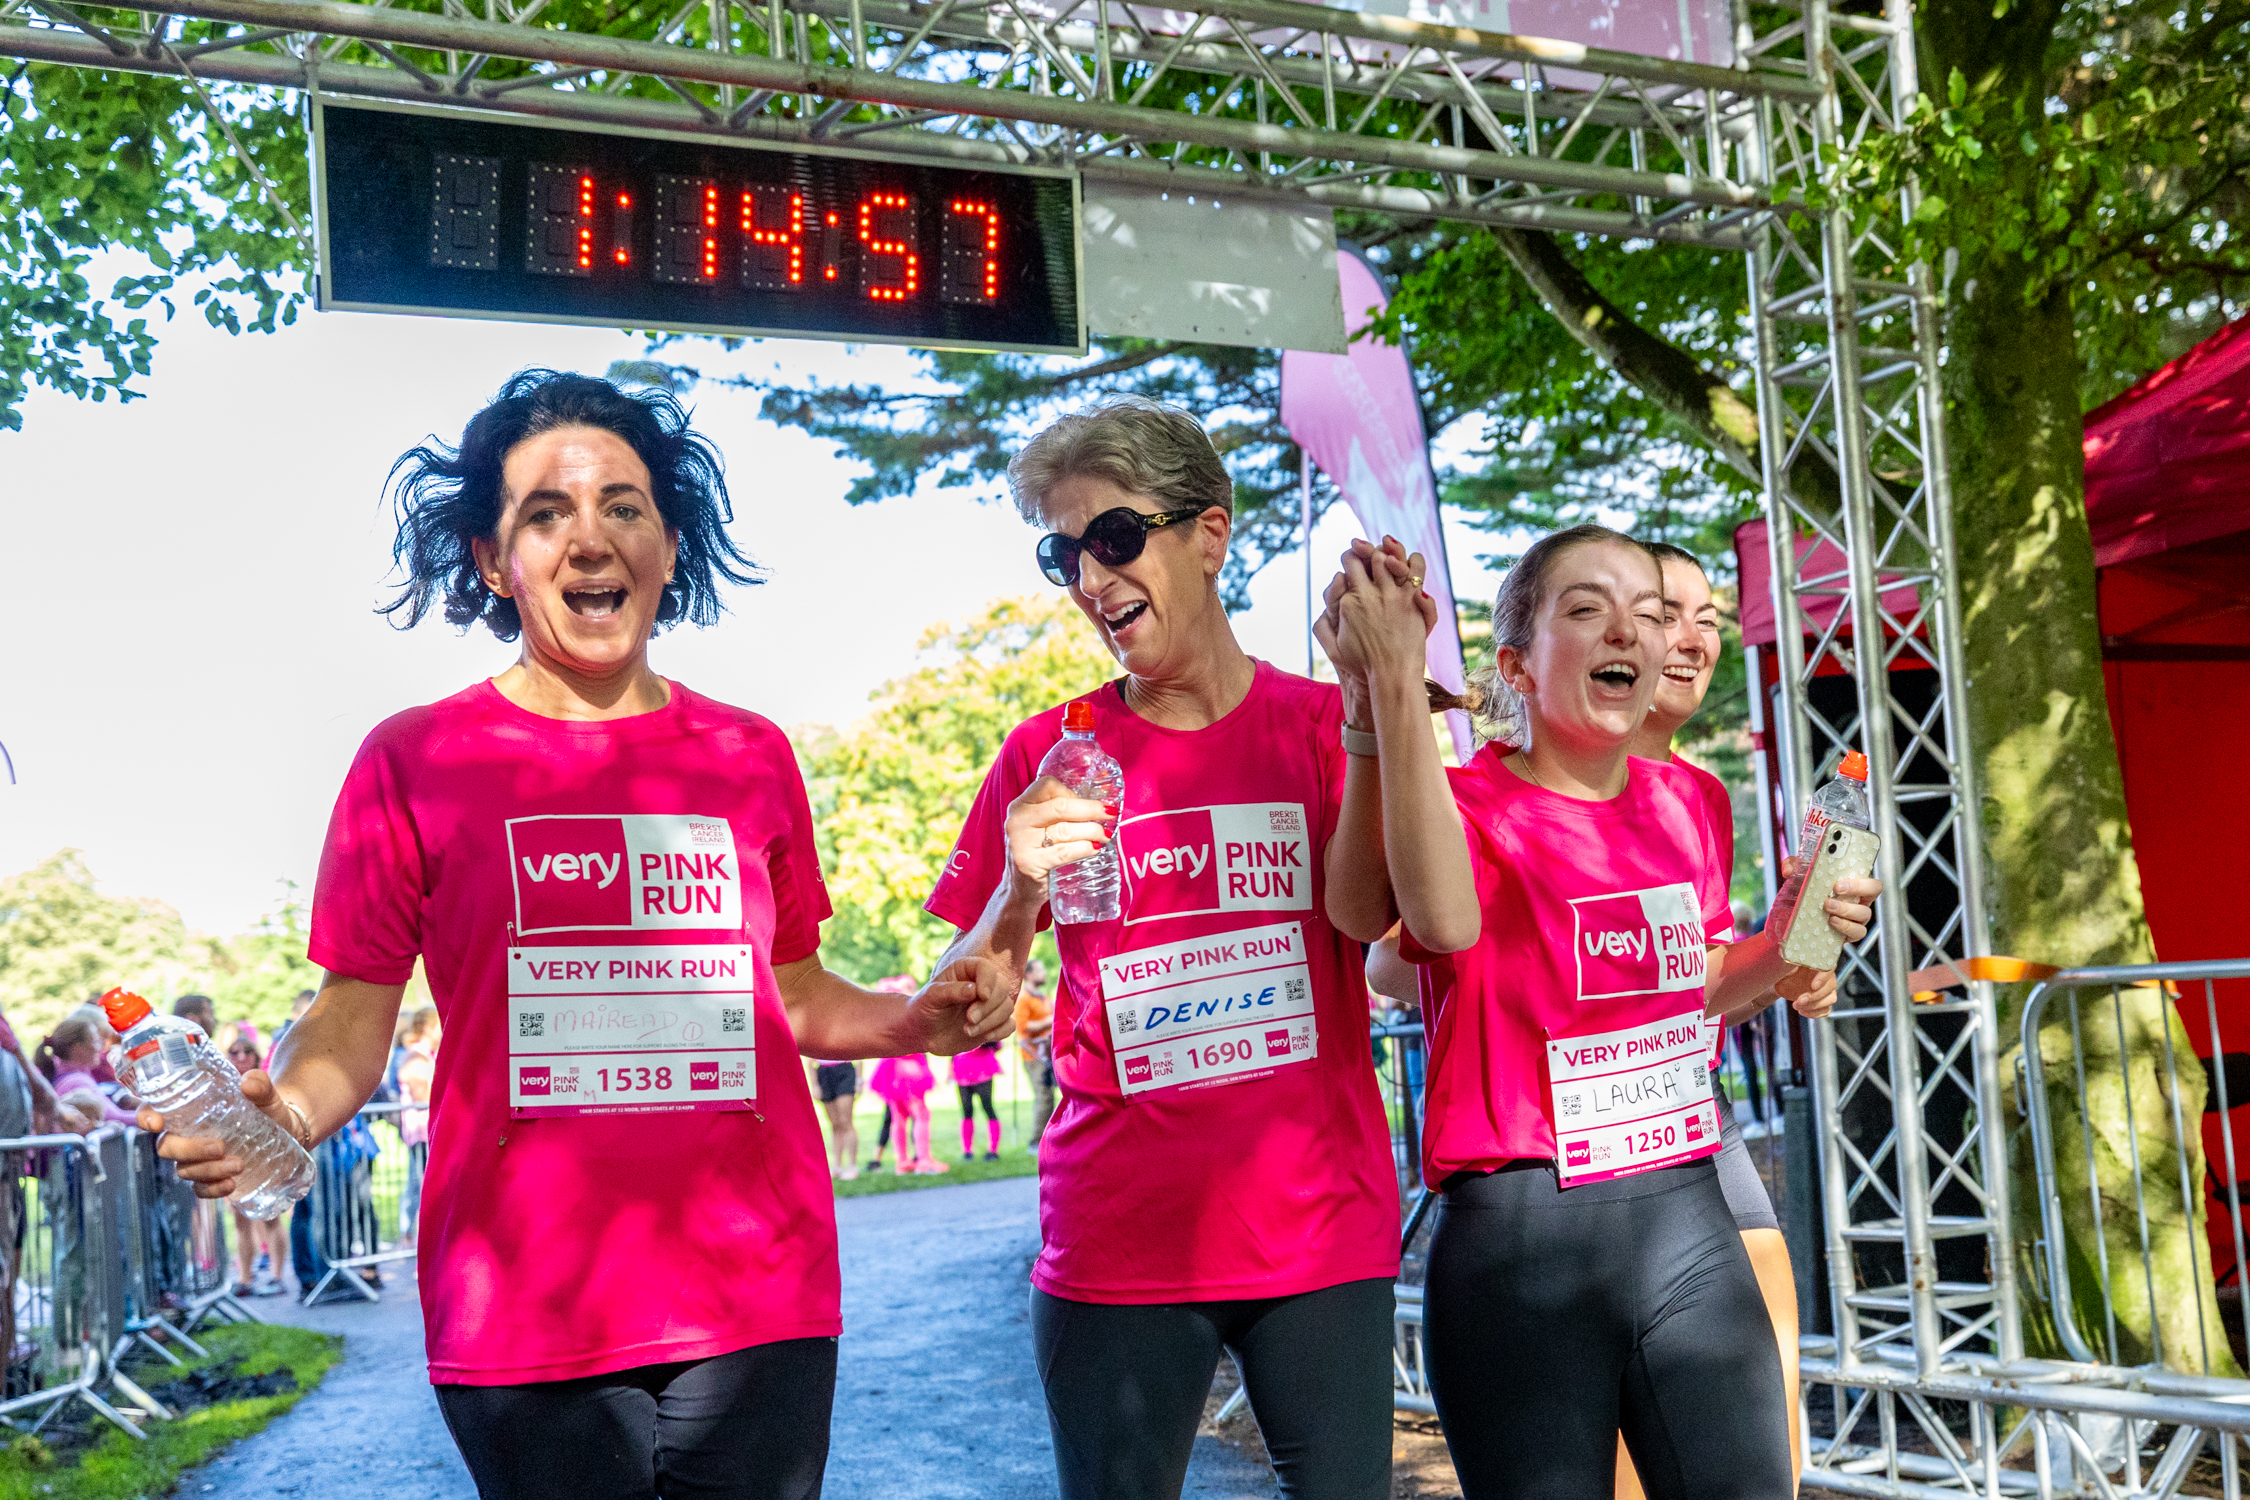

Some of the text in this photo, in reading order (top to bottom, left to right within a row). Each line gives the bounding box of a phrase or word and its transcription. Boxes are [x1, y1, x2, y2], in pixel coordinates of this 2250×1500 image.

[690, 830, 724, 838] CANCER
[1225, 841, 1302, 868] PINK
[640, 853, 731, 881] PINK
[1130, 844, 1209, 879] very
[522, 852, 620, 889] very
[1228, 872, 1294, 899] RUN
[643, 885, 721, 915] RUN
[1659, 921, 1704, 951] PINK
[1585, 928, 1647, 962] very
[1114, 936, 1292, 984] VERY PINK RUN
[1666, 951, 1704, 980] RUN
[527, 959, 736, 980] VERY PINK RUN
[1144, 986, 1277, 1031] DENISE
[1267, 1037, 1289, 1048] very
[1291, 1034, 1310, 1044] PINK
[1563, 1024, 1697, 1067] VERY PINK RUN
[1292, 1041, 1310, 1051] RUN
[1187, 1039, 1253, 1069] 1690
[1126, 1063, 1150, 1076] very
[1152, 1059, 1174, 1070] PINK
[691, 1070, 718, 1082] very
[721, 1070, 746, 1080] PINK
[1154, 1067, 1174, 1077] RUN
[521, 1076, 549, 1087] very
[553, 1075, 579, 1084] PINK
[597, 1066, 673, 1092] 1538
[722, 1079, 744, 1088] RUN
[554, 1084, 577, 1093] RUN
[1593, 1071, 1679, 1113] LAURA
[1701, 1119, 1714, 1129] PINK
[1703, 1126, 1714, 1136] RUN
[1624, 1125, 1676, 1155] 1250
[1567, 1147, 1590, 1159] very
[1592, 1145, 1612, 1154] PINK
[1593, 1153, 1611, 1161] RUN
